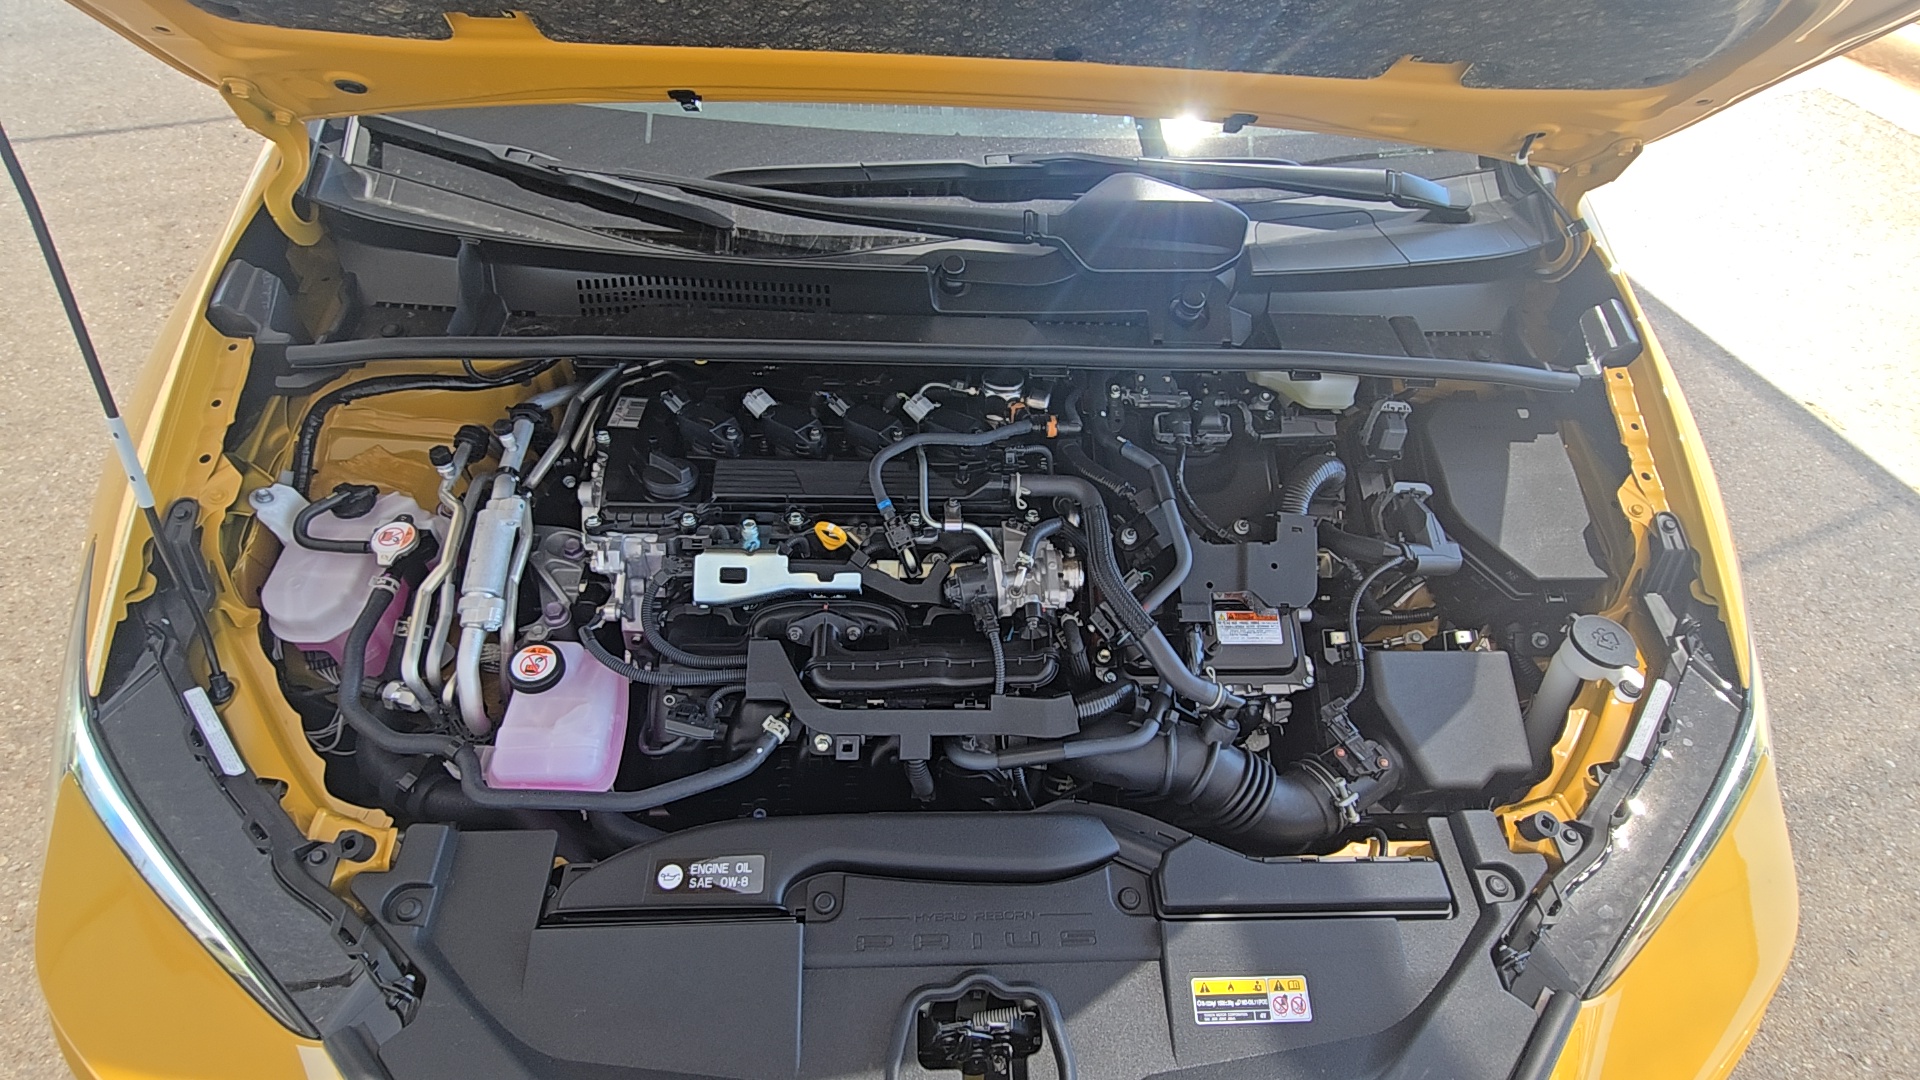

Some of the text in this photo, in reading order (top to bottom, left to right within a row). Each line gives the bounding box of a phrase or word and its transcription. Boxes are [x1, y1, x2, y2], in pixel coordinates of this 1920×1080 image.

[690, 863, 752, 874] ENGINE OIL
[689, 876, 748, 888] SAE 0W-8
[914, 911, 1035, 923] HYBRID REBORN
[855, 930, 1098, 952] PRIUS
